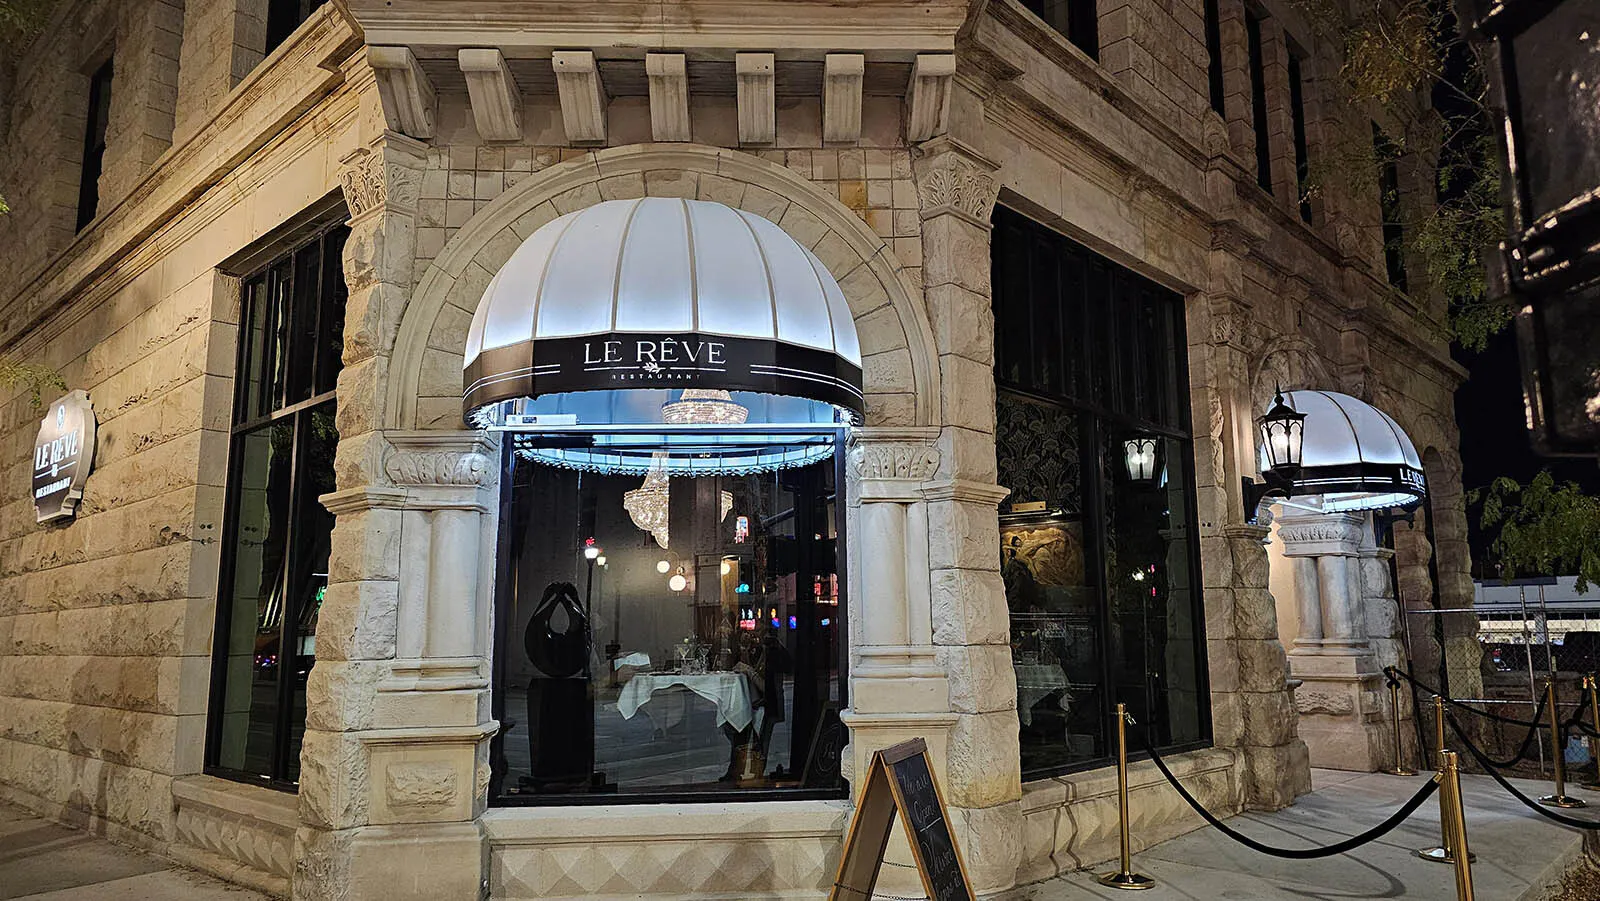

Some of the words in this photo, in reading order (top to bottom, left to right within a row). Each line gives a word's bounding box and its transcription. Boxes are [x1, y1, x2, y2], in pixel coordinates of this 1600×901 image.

[584, 341, 623, 364] LE
[636, 337, 727, 364] RÊVE
[36, 444, 49, 470] LE
[1399, 468, 1412, 481] LE
